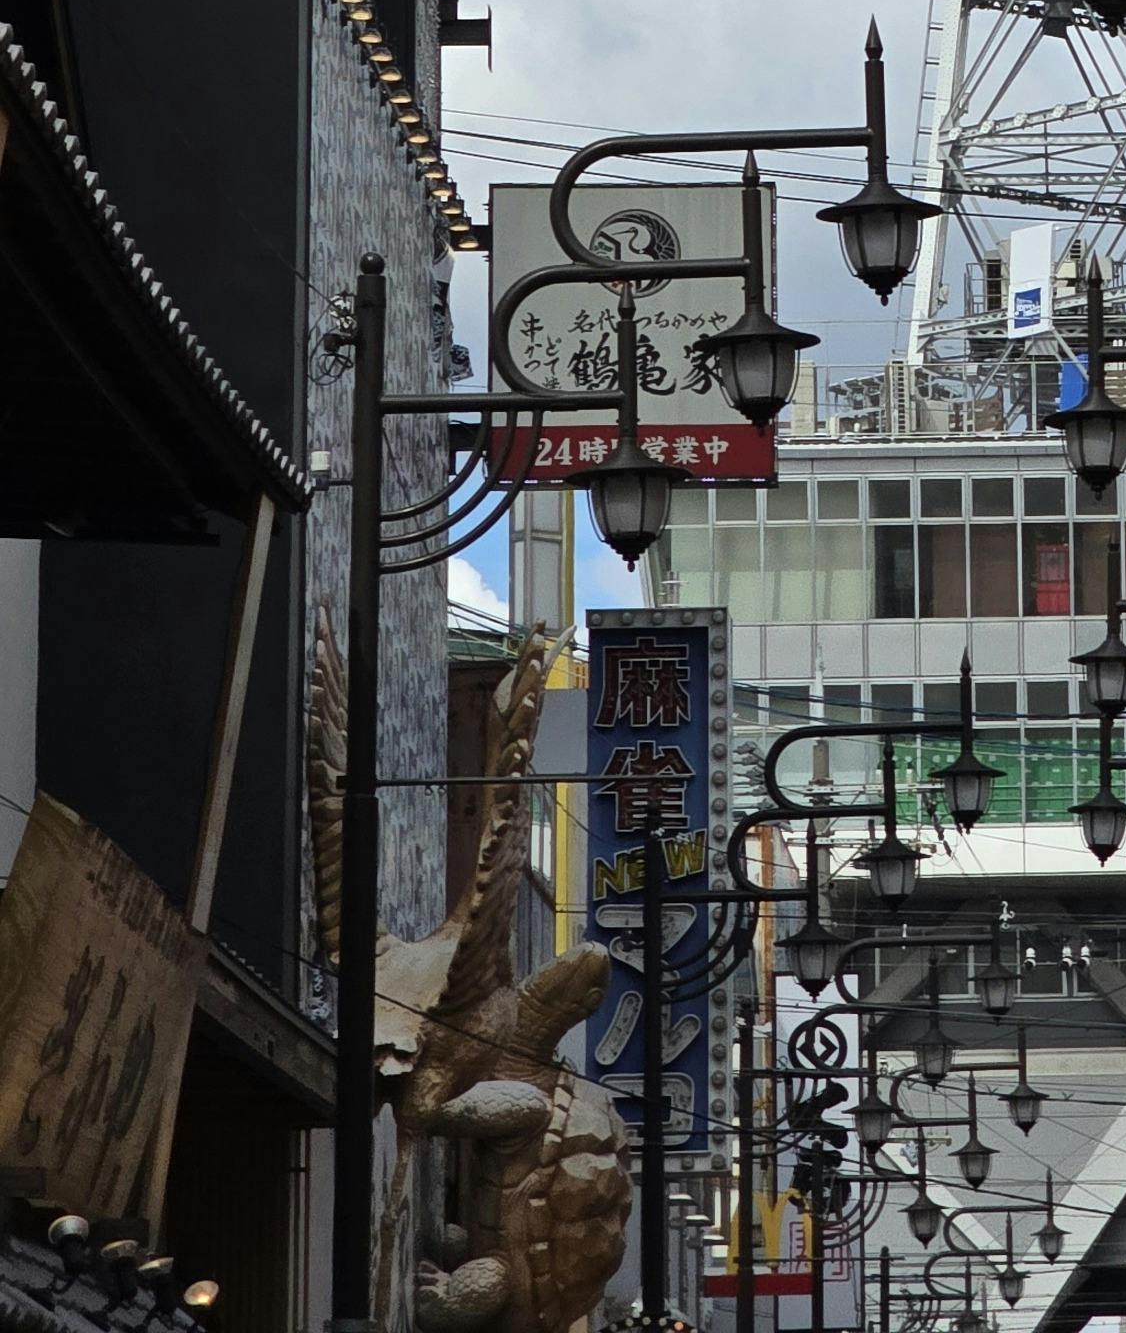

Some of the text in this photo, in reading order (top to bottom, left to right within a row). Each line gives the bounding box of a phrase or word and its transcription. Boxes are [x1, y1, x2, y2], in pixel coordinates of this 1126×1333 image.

[534, 435, 729, 467] 24時営業中
[593, 636, 697, 833] 麻雀
